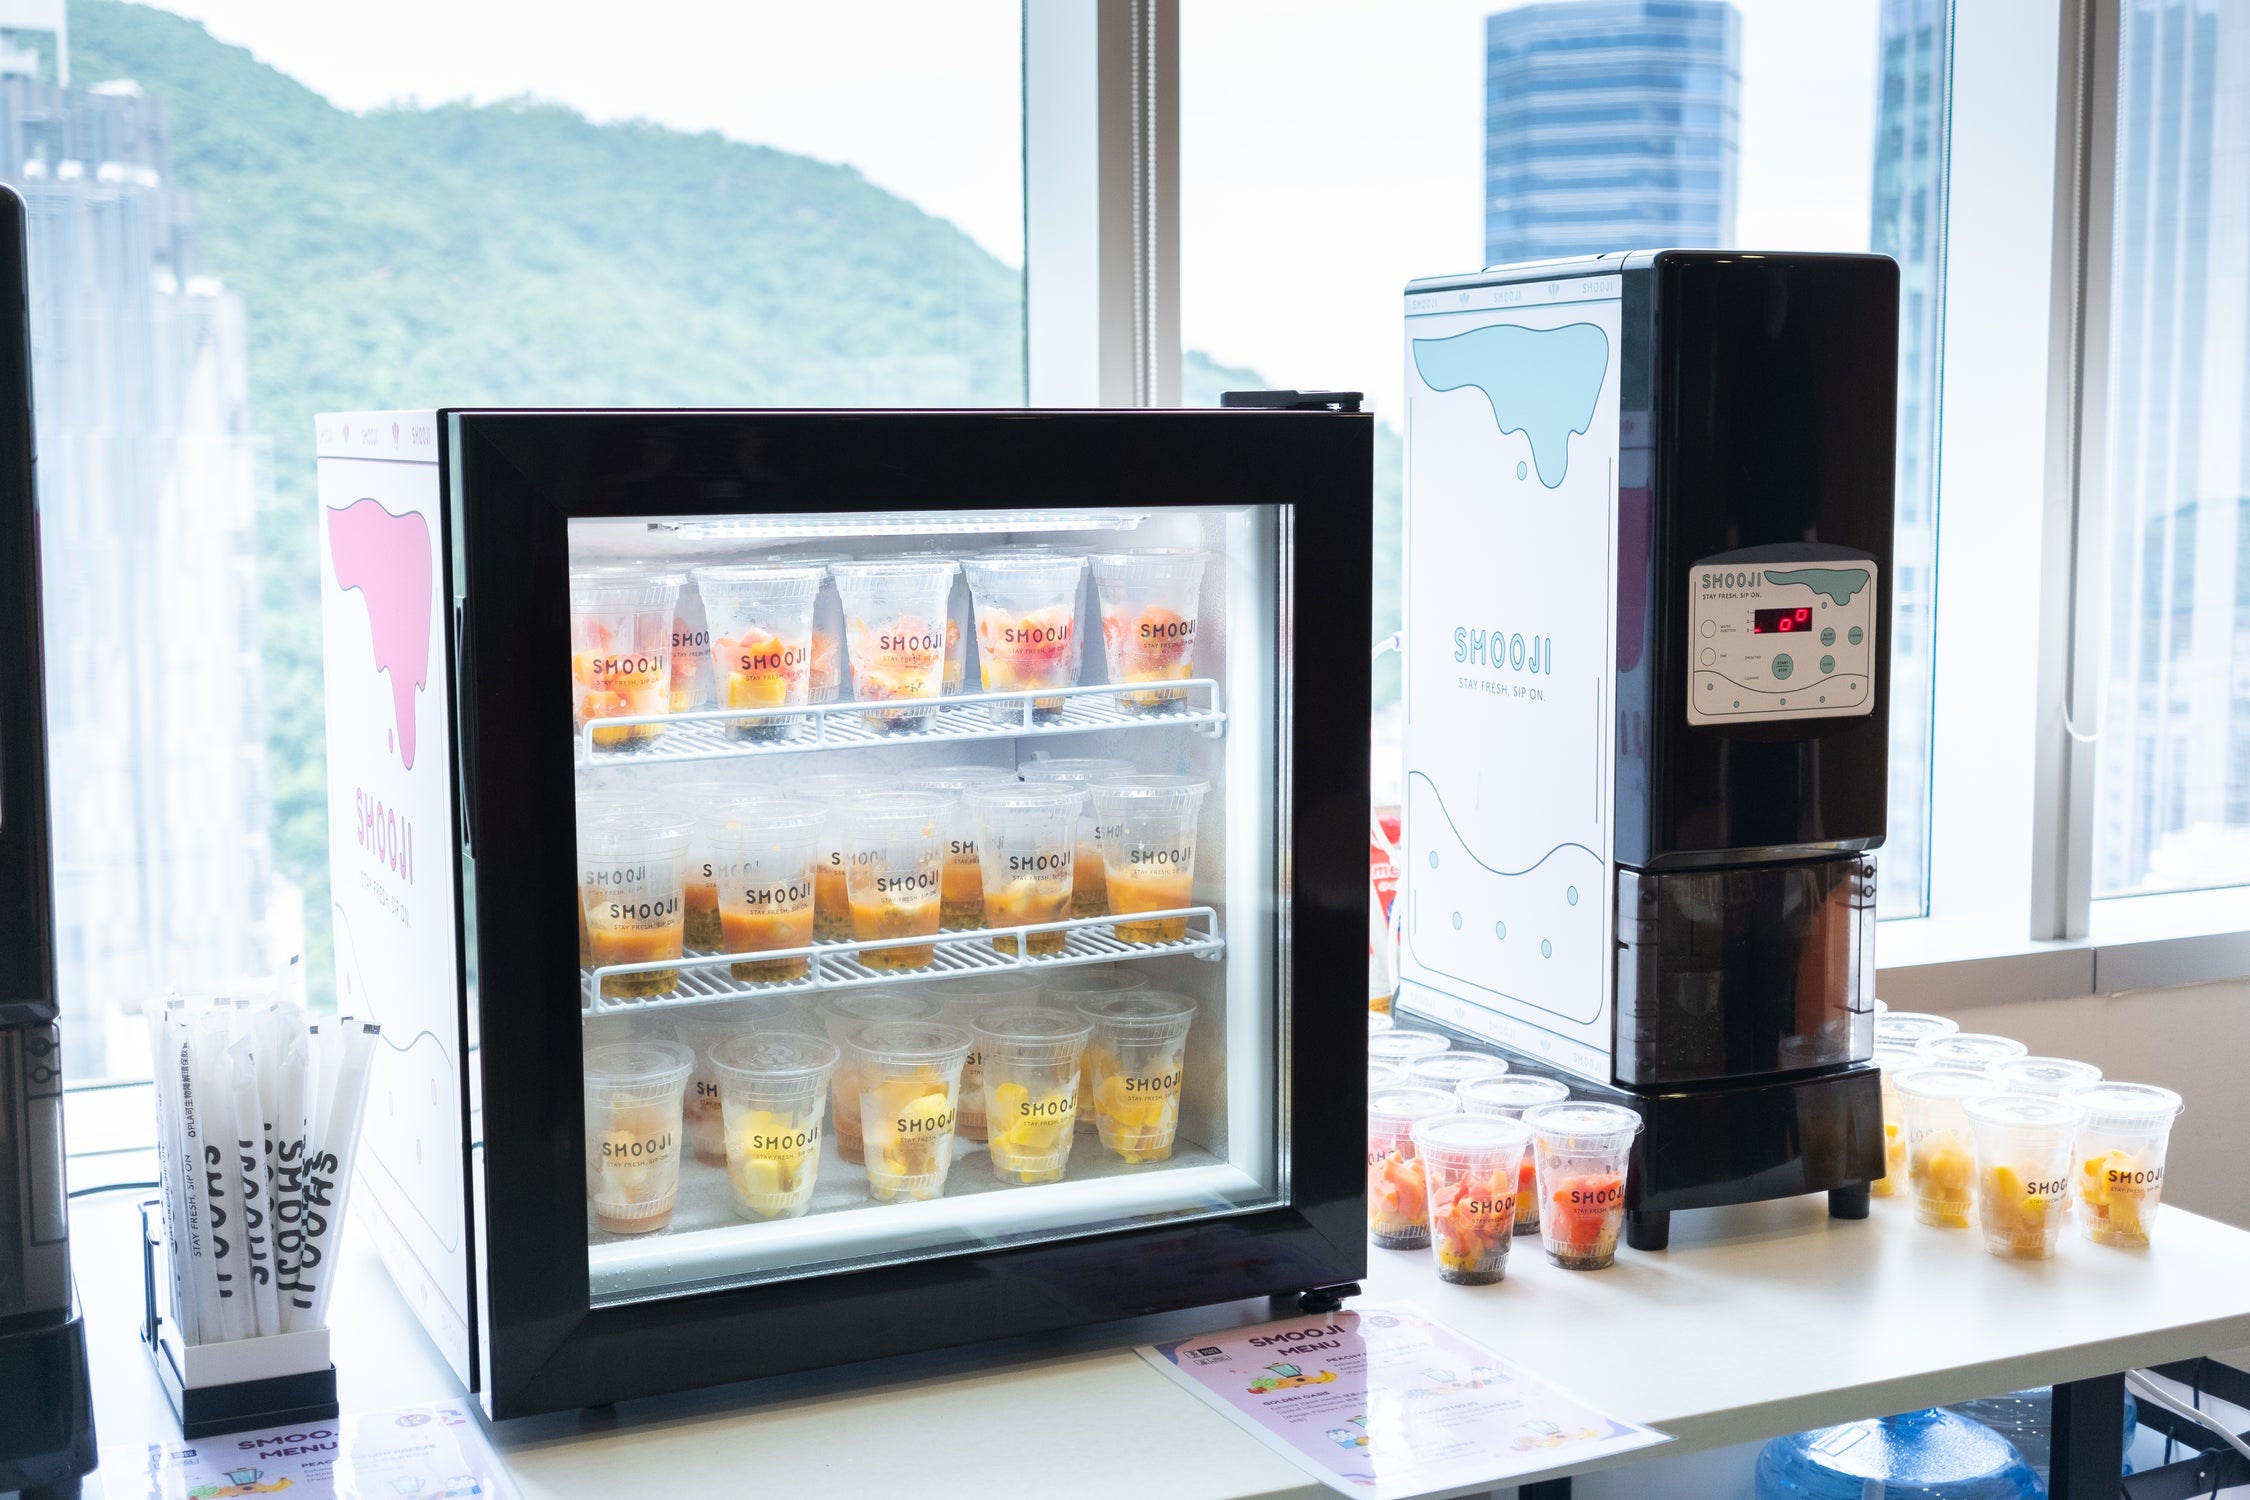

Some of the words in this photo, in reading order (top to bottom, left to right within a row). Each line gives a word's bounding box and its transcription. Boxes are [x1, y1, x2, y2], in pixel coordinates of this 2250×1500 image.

[1582, 280, 1613, 294] SMOOJI
[1702, 572, 1761, 589] SMOOJI
[1005, 625, 1067, 643] SMOOJI
[1141, 619, 1196, 638] SMOOJI
[880, 633, 942, 651] SMOOJI
[1454, 626, 1551, 675] SMOOJI
[593, 655, 663, 675] SMOOJI
[741, 647, 806, 670] SMOOJI
[1459, 677, 1478, 691] STAY
[1513, 685, 1526, 698] SIP
[356, 786, 414, 886] SMOOJI
[1009, 851, 1071, 871] SMOOJI
[1131, 847, 1191, 865] SMOOJI
[586, 865, 646, 885] SMOOJI
[877, 870, 939, 893] SMOOJI
[746, 882, 811, 905] SMOOJI
[610, 897, 678, 920] SMOOJI
[1125, 1071, 1181, 1092] SMOOJI
[1020, 1095, 1077, 1117] SMOOJI
[897, 1108, 955, 1133] SMOOJI
[602, 1132, 672, 1158] SMOOJI
[753, 1127, 818, 1151] SMOOJI
[187, 1176, 195, 1191] SIP
[2108, 1166, 2163, 1184] SMOOJI
[1571, 1184, 1624, 1204] SMOOJI
[278, 1139, 303, 1291] SMOOJI
[192, 1235, 201, 1257] STAY
[1248, 1324, 1346, 1347] SMOOJI
[1277, 1340, 1341, 1356] MENU
[237, 1430, 339, 1450] SMOO
[259, 1442, 338, 1460] MENU
